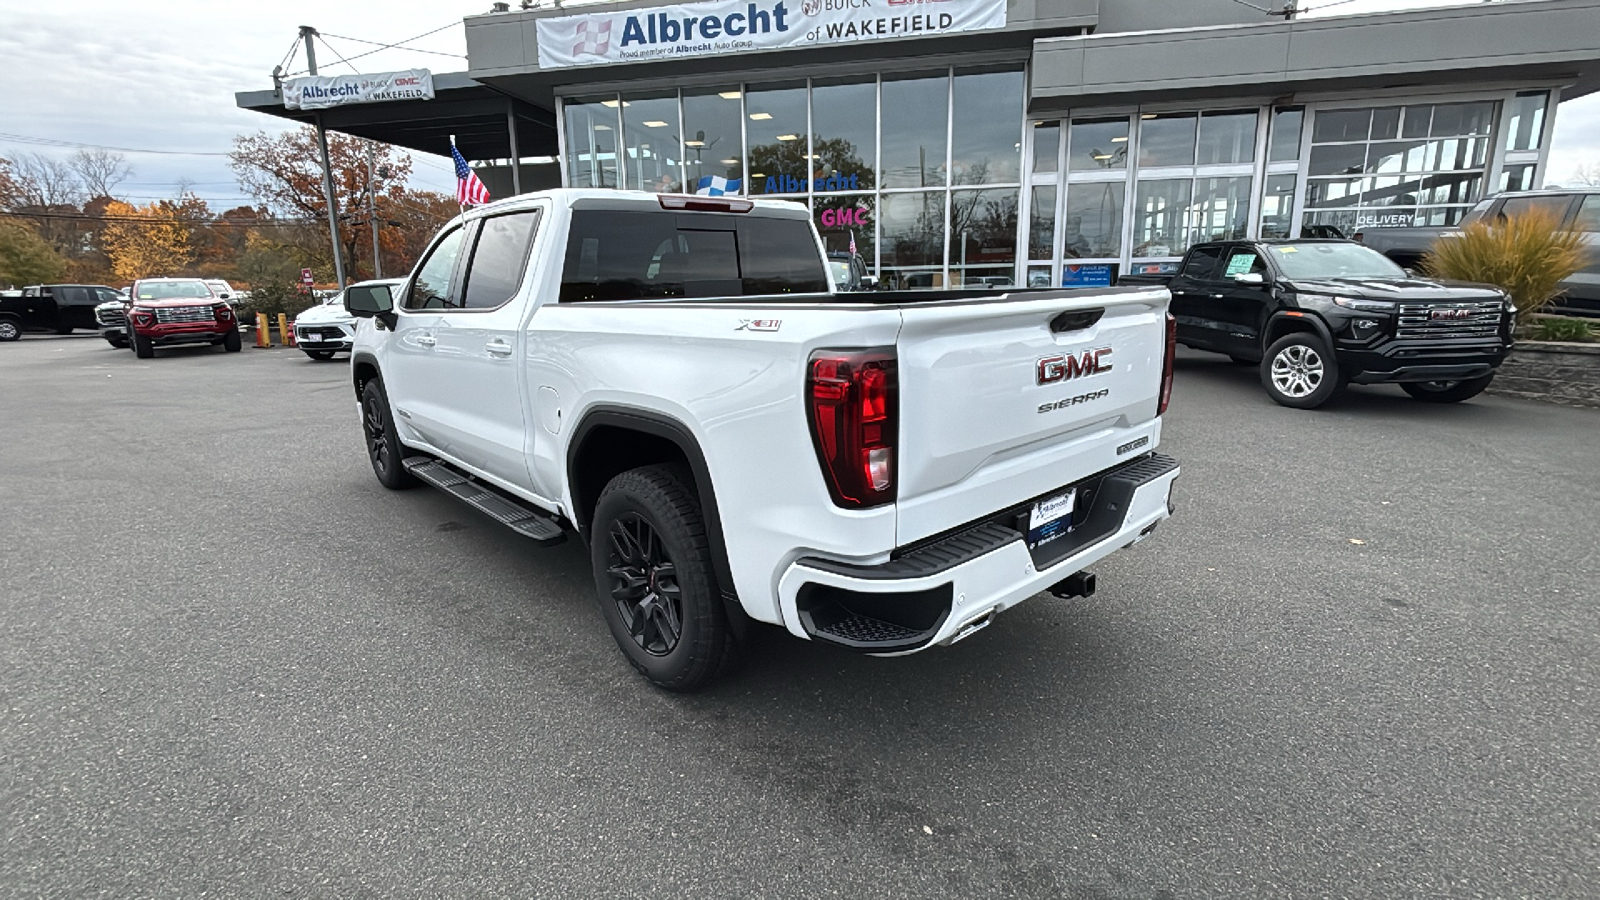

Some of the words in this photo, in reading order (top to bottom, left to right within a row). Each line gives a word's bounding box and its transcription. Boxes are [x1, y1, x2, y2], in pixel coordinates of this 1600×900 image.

[825, 0, 872, 11] BUICK
[620, 1, 789, 47] Albrecht
[806, 27, 820, 41] of
[826, 13, 953, 39] WAKEFIELD
[619, 49, 639, 58] Proud
[640, 46, 665, 57] member
[675, 43, 711, 54] Albrecht
[713, 41, 730, 50] Auto
[731, 39, 753, 49] Group
[302, 82, 360, 99] Albrecht
[395, 77, 420, 87] GMC
[373, 89, 423, 101] WAKEFIELD
[765, 173, 858, 193] Albrecht
[821, 207, 868, 227] GMC
[1359, 214, 1413, 224] DELIVERY
[1036, 345, 1114, 386] GMC
[1038, 388, 1109, 414] SIERRA
